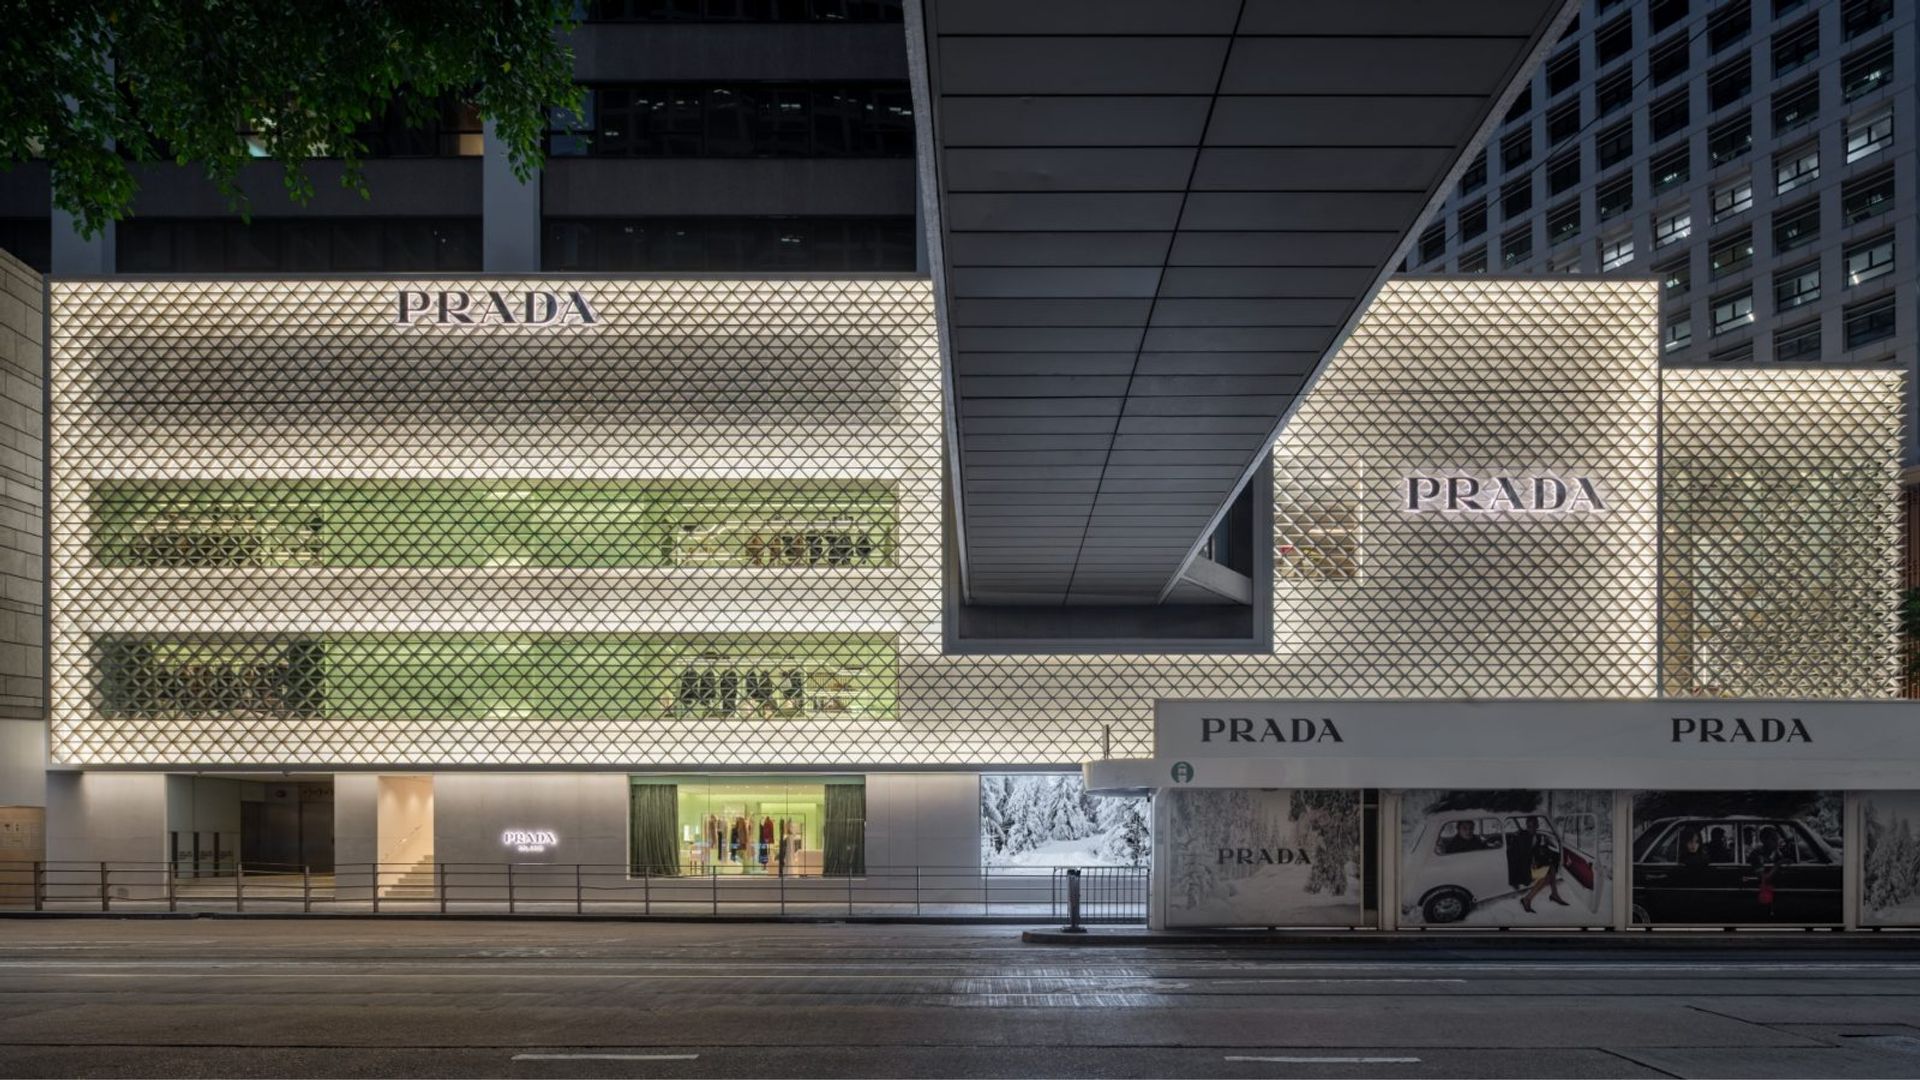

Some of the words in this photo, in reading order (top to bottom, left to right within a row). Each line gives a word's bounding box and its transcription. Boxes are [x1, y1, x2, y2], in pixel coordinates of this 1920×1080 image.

[398, 291, 596, 324] PRADA
[1407, 477, 1605, 510] PRADA
[1201, 718, 1343, 742] PRADA
[1671, 718, 1813, 742] PRADA
[504, 832, 556, 844] PRADA
[1217, 848, 1311, 865] PRADA
